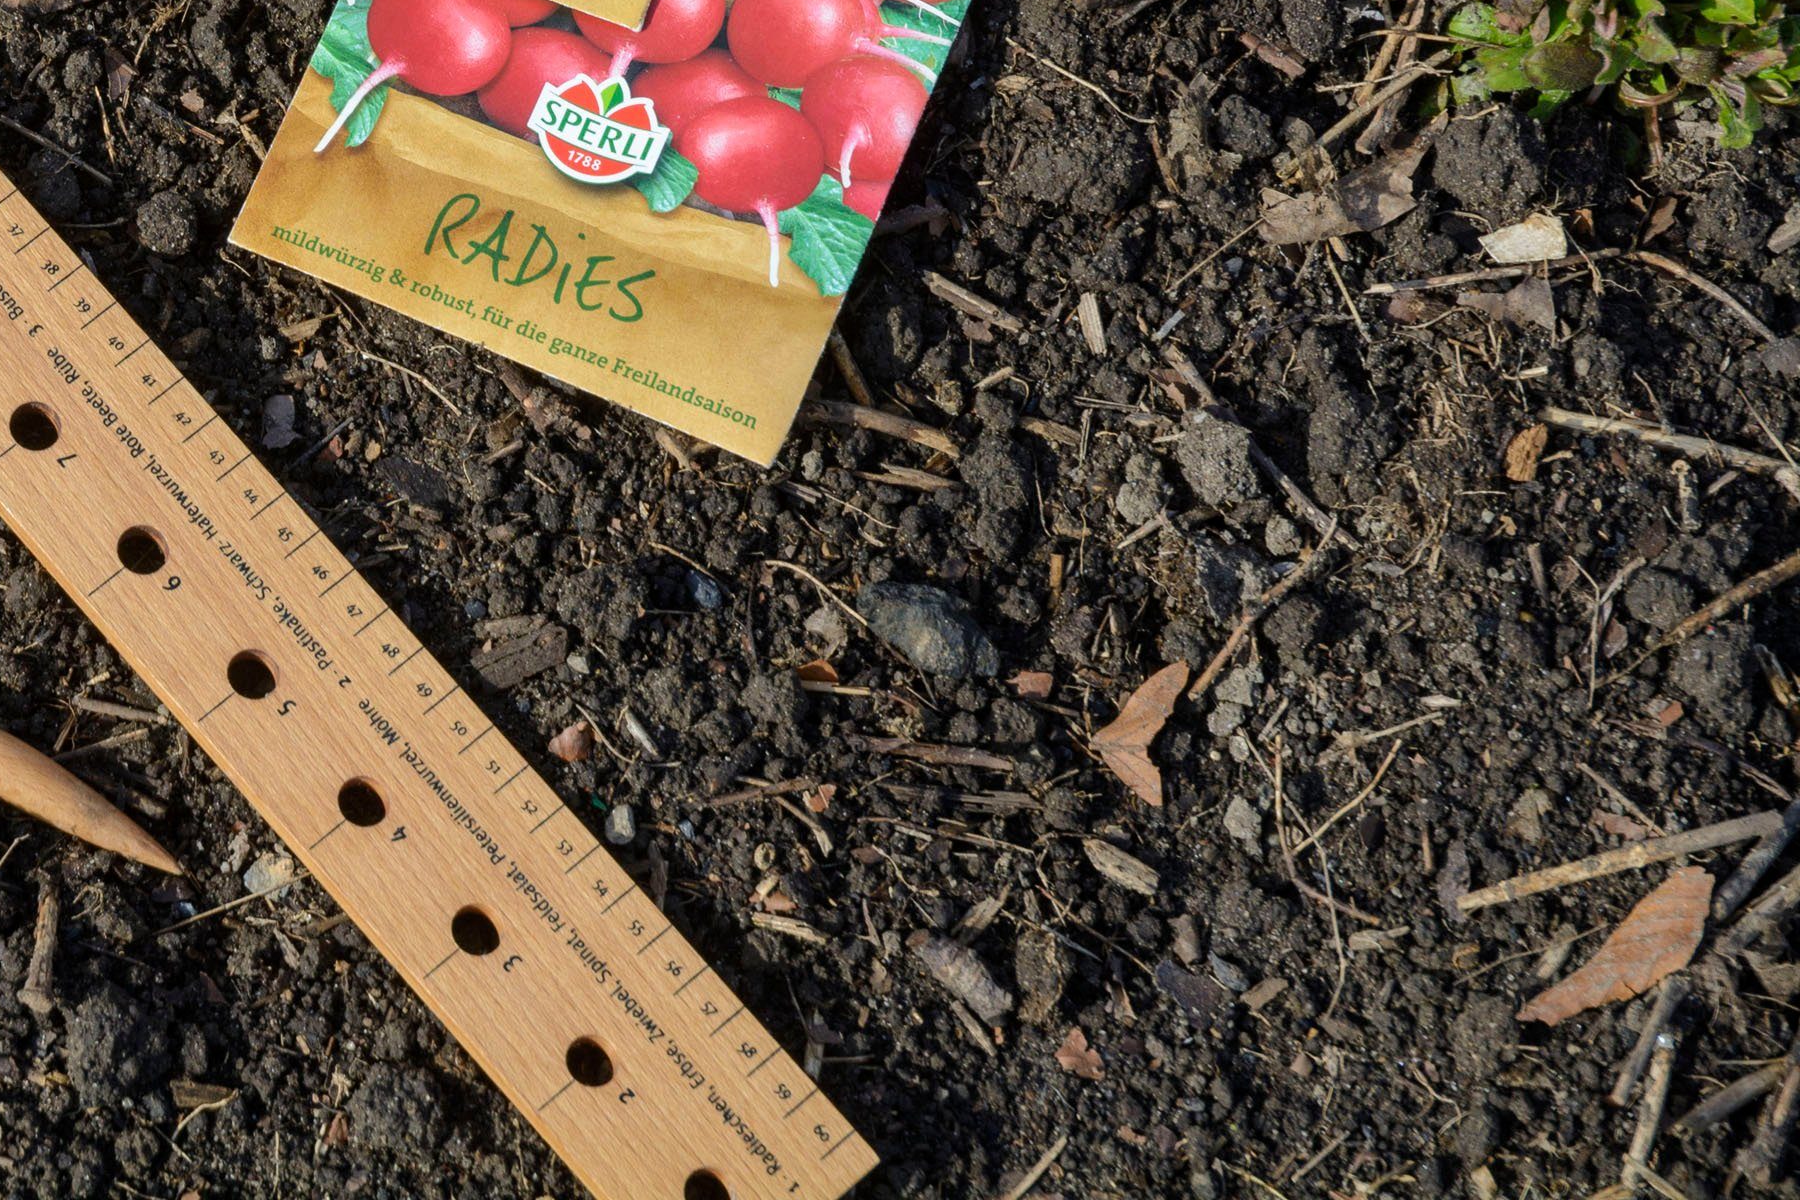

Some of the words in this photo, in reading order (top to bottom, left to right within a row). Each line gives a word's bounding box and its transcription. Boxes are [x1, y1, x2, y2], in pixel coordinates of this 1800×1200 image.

[540, 99, 655, 161] SPERLI
[567, 150, 602, 171] 1788
[27, 323, 45, 339] 3
[271, 225, 386, 284] mildwürzig
[388, 268, 408, 288] &
[409, 280, 478, 320] robust,
[481, 305, 514, 330] für
[516, 319, 548, 345] die
[548, 336, 609, 369] ganze
[611, 357, 759, 430] Freilandsaison
[46, 346, 82, 386] Rübe
[80, 379, 120, 429] Beete,
[55, 452, 78, 470] 7
[114, 423, 147, 460] Rote
[142, 453, 219, 542] Haferwurzel,
[161, 574, 183, 592] 6
[272, 595, 335, 672] Pastinake,
[6, 222, 26, 237] 37
[39, 258, 61, 276] 38
[72, 296, 92, 314] 39
[107, 335, 126, 352] 40
[141, 373, 158, 388] 41
[171, 411, 193, 427] 42
[208, 449, 226, 466] 43
[242, 488, 260, 506] 44
[277, 526, 295, 543] 45
[311, 564, 331, 581] 46
[345, 603, 364, 619] 47
[380, 642, 401, 659] 48
[415, 682, 434, 698] 49
[448, 719, 469, 737] 50
[484, 759, 502, 775] 51
[519, 798, 539, 816] 52
[555, 838, 575, 857] 53
[591, 878, 609, 899] 54
[628, 918, 646, 938] 55
[664, 959, 683, 978] 56
[699, 1001, 720, 1017] 57
[735, 1041, 759, 1059] 58
[773, 1082, 793, 1101] 59
[812, 1123, 831, 1144] 60
[337, 674, 353, 690] 2
[276, 699, 298, 717] 5
[357, 697, 401, 747] Möhre
[398, 741, 507, 866] Petersilienwurzel,
[390, 825, 408, 843] 4
[505, 860, 567, 934] Feldsalat,
[502, 954, 525, 974] 3
[565, 927, 613, 985] Spinat,
[609, 978, 666, 1045] Zwiebel,
[665, 1038, 706, 1090] Erbse,
[618, 1087, 636, 1106] 2
